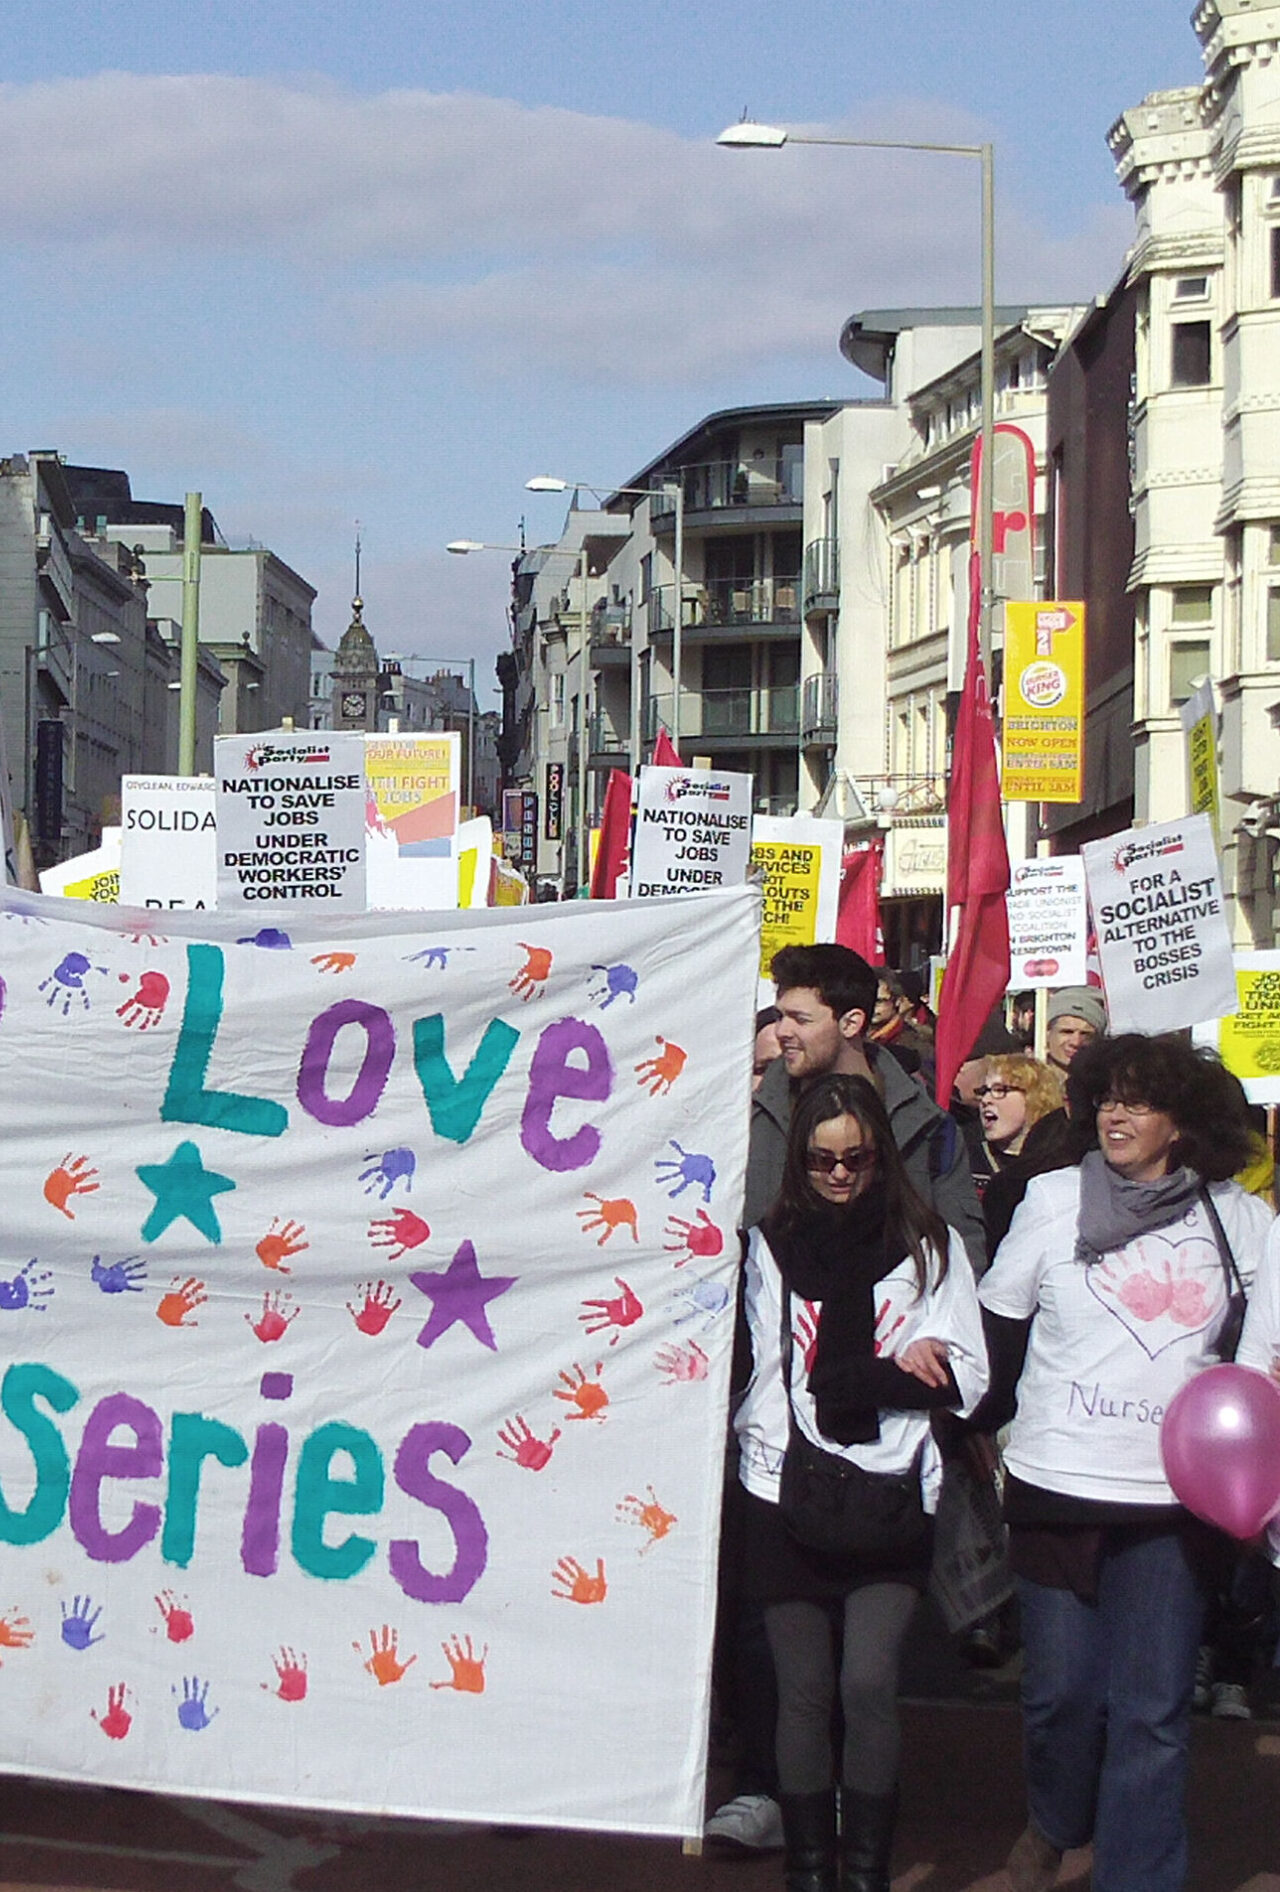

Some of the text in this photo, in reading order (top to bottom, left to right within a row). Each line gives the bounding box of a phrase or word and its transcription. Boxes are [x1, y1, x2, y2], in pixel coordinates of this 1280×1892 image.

[1027, 680, 1061, 696] KING
[262, 744, 330, 757] Socialist
[222, 775, 360, 793] NATIONALISE
[402, 776, 448, 789] FIGHT
[247, 793, 335, 809] TO SAVE
[127, 809, 217, 832] SOLIDA
[263, 811, 319, 826] JOBS
[643, 808, 748, 829] NATIONALISE
[256, 833, 328, 849] UNDER
[663, 827, 731, 846] TO SAVE
[1127, 834, 1182, 855] Socialist
[224, 849, 360, 867] DEMOCRATIC
[675, 846, 718, 862] JOBS
[780, 850, 813, 862] AND
[238, 865, 346, 883] WORKERS'
[667, 868, 723, 885] UNDER
[1130, 869, 1181, 895] FOR A
[243, 884, 342, 900] CONTROL
[1056, 884, 1078, 893] THE
[773, 900, 804, 912] THE
[1100, 877, 1215, 925] SOCIALIST
[1104, 899, 1220, 944] ALTERNATIVE
[1019, 932, 1076, 943] BRIGHTON
[1134, 925, 1196, 953] TO THE
[1134, 943, 1202, 973] BOSSES
[1143, 963, 1199, 990] CRISIS
[1252, 982, 1280, 991] YO
[1234, 1021, 1275, 1030] FIGHT
[159, 944, 614, 1172] Love
[1068, 1381, 1163, 1425] Nurse
